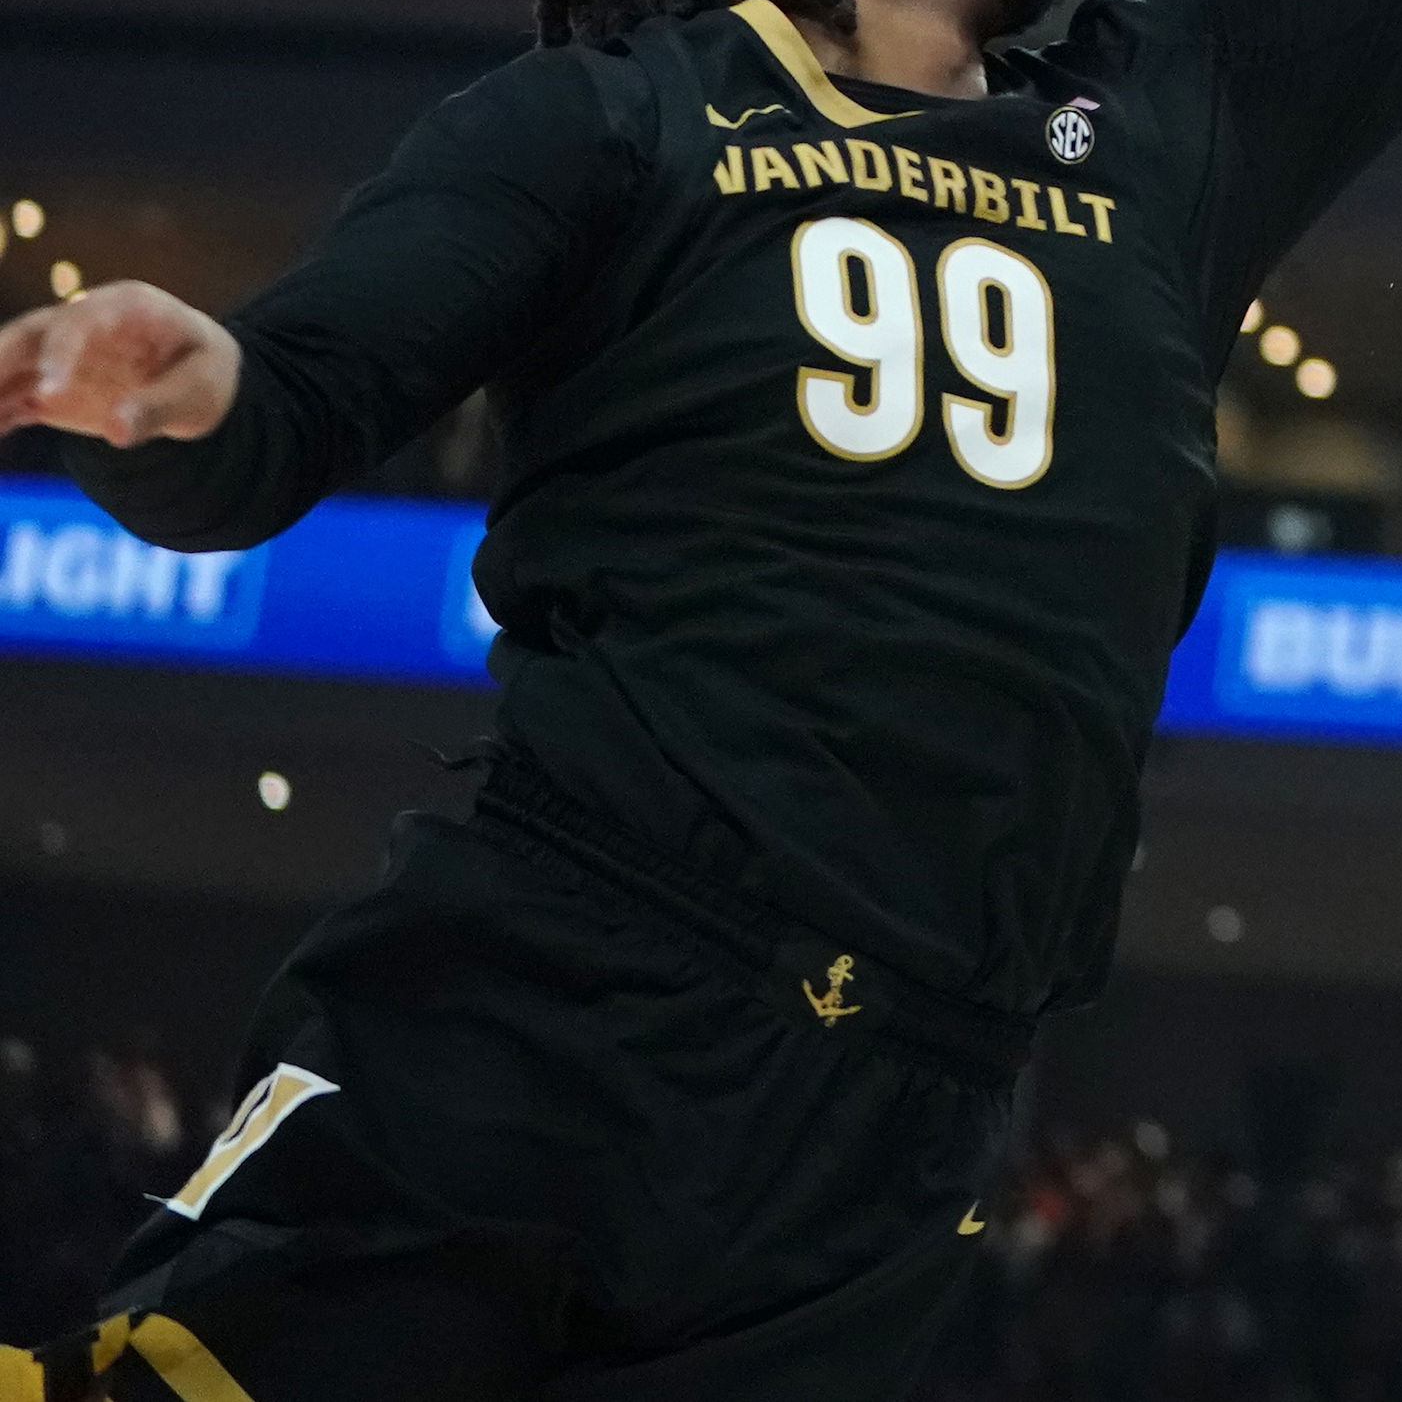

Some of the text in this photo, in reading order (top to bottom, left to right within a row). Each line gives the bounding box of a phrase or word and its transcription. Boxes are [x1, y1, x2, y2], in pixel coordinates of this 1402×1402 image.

[1051, 111, 1091, 159] SEC
[713, 139, 1116, 244] VANDERBILT
[790, 216, 1056, 490] 99
[0, 520, 246, 622] IGHT
